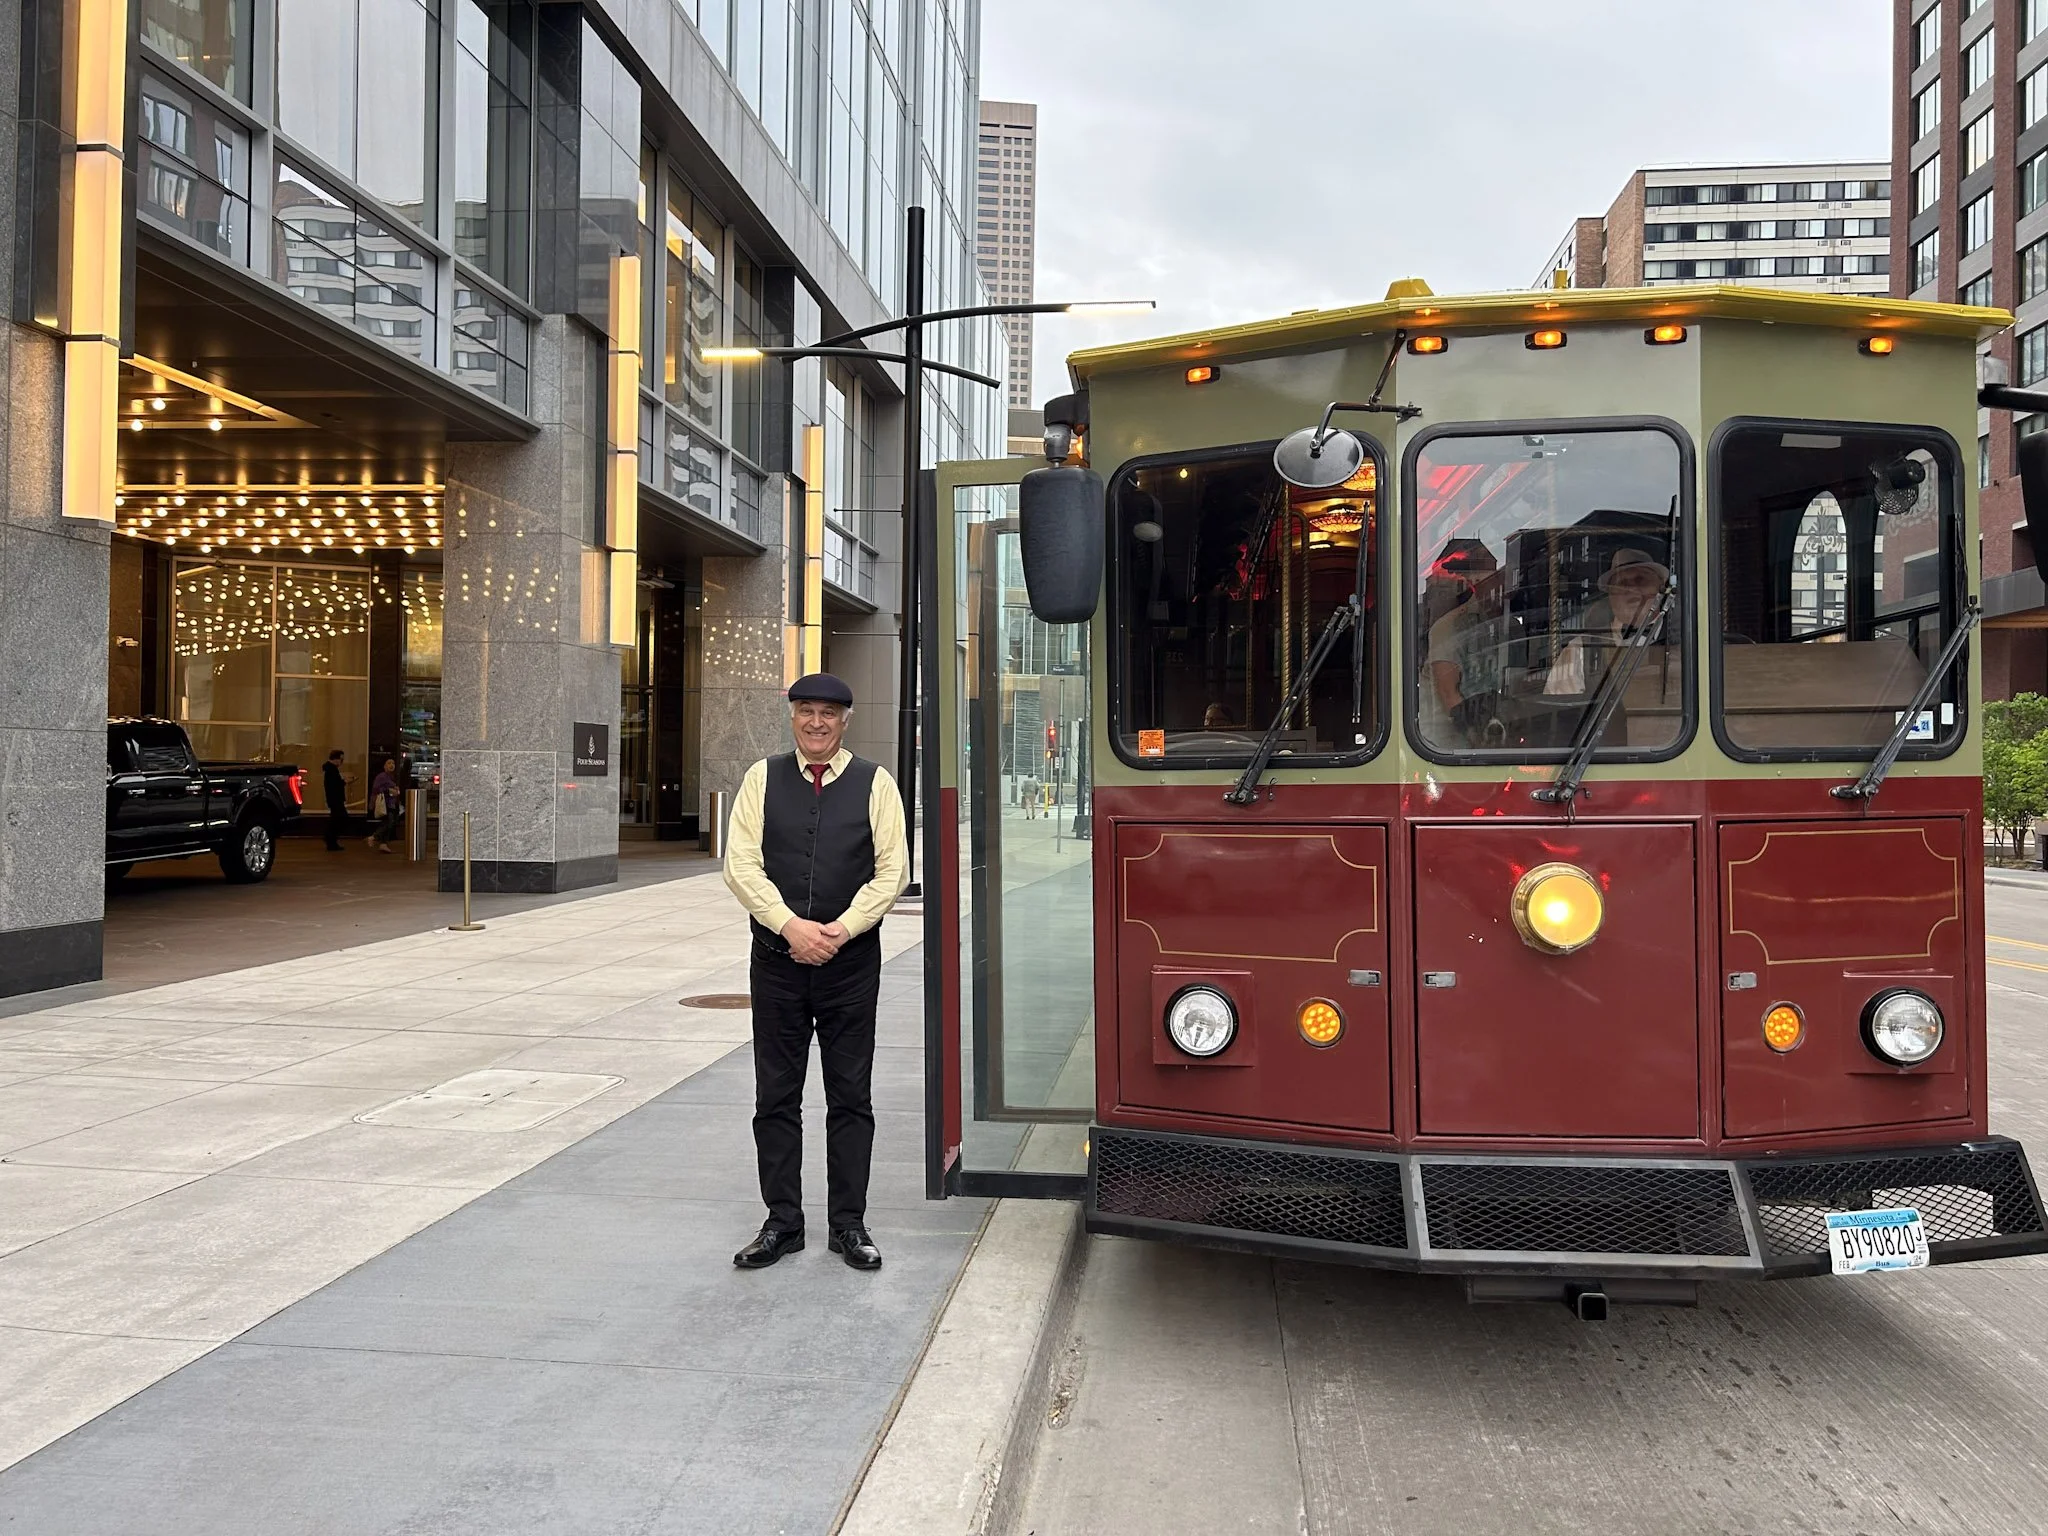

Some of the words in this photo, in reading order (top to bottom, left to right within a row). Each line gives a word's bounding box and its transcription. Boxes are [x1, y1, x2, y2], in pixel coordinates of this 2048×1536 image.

[1922, 720, 1929, 730] 21
[577, 758, 587, 766] FOUR
[588, 758, 605, 766] SEASONS
[1848, 1213, 1894, 1224] Minnesota
[1840, 1225, 1915, 1259] BY90820
[1839, 1260, 1850, 1269] FEB
